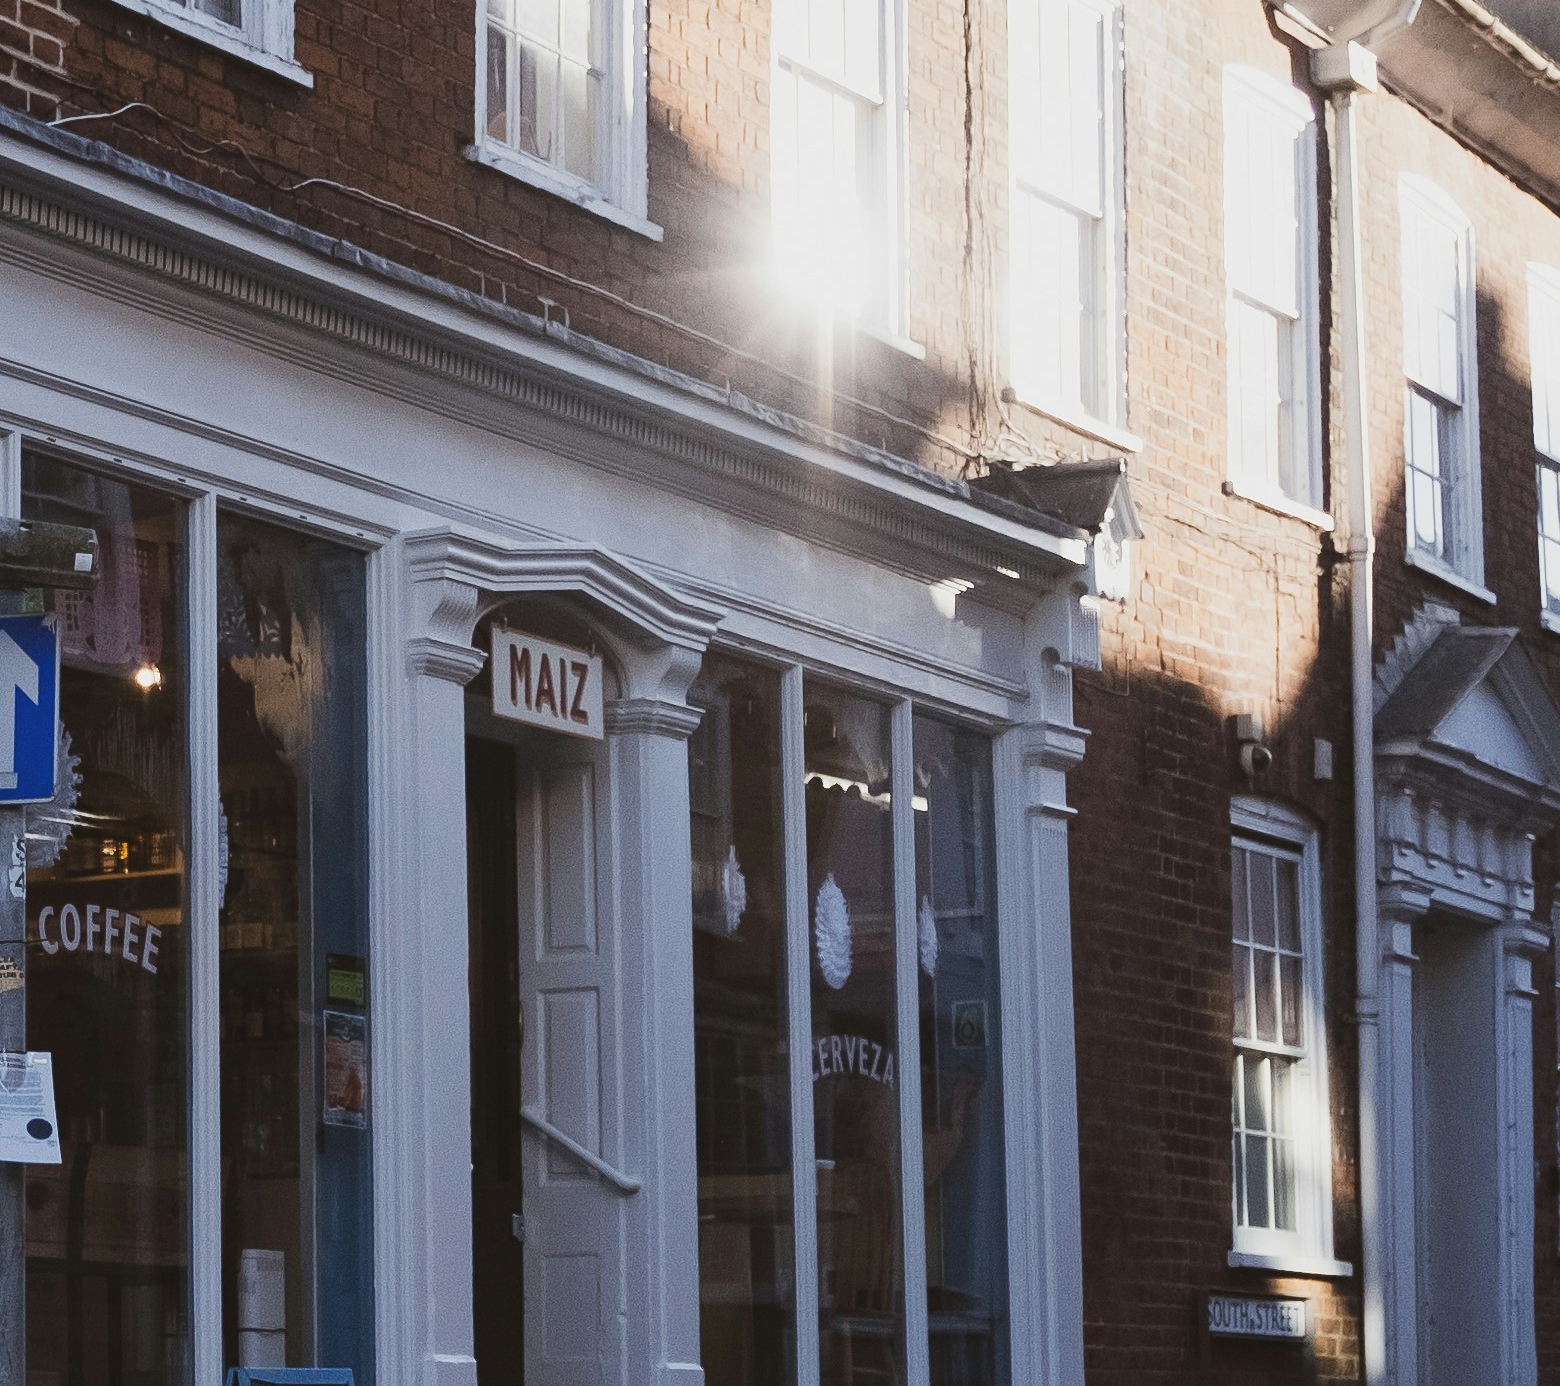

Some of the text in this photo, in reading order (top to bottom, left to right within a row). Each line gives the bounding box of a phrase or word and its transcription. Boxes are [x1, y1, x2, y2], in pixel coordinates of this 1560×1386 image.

[509, 643, 589, 726] MAIZ
[38, 903, 162, 974] COFFEE
[1208, 1299, 1300, 1332] SOUTH STREET
